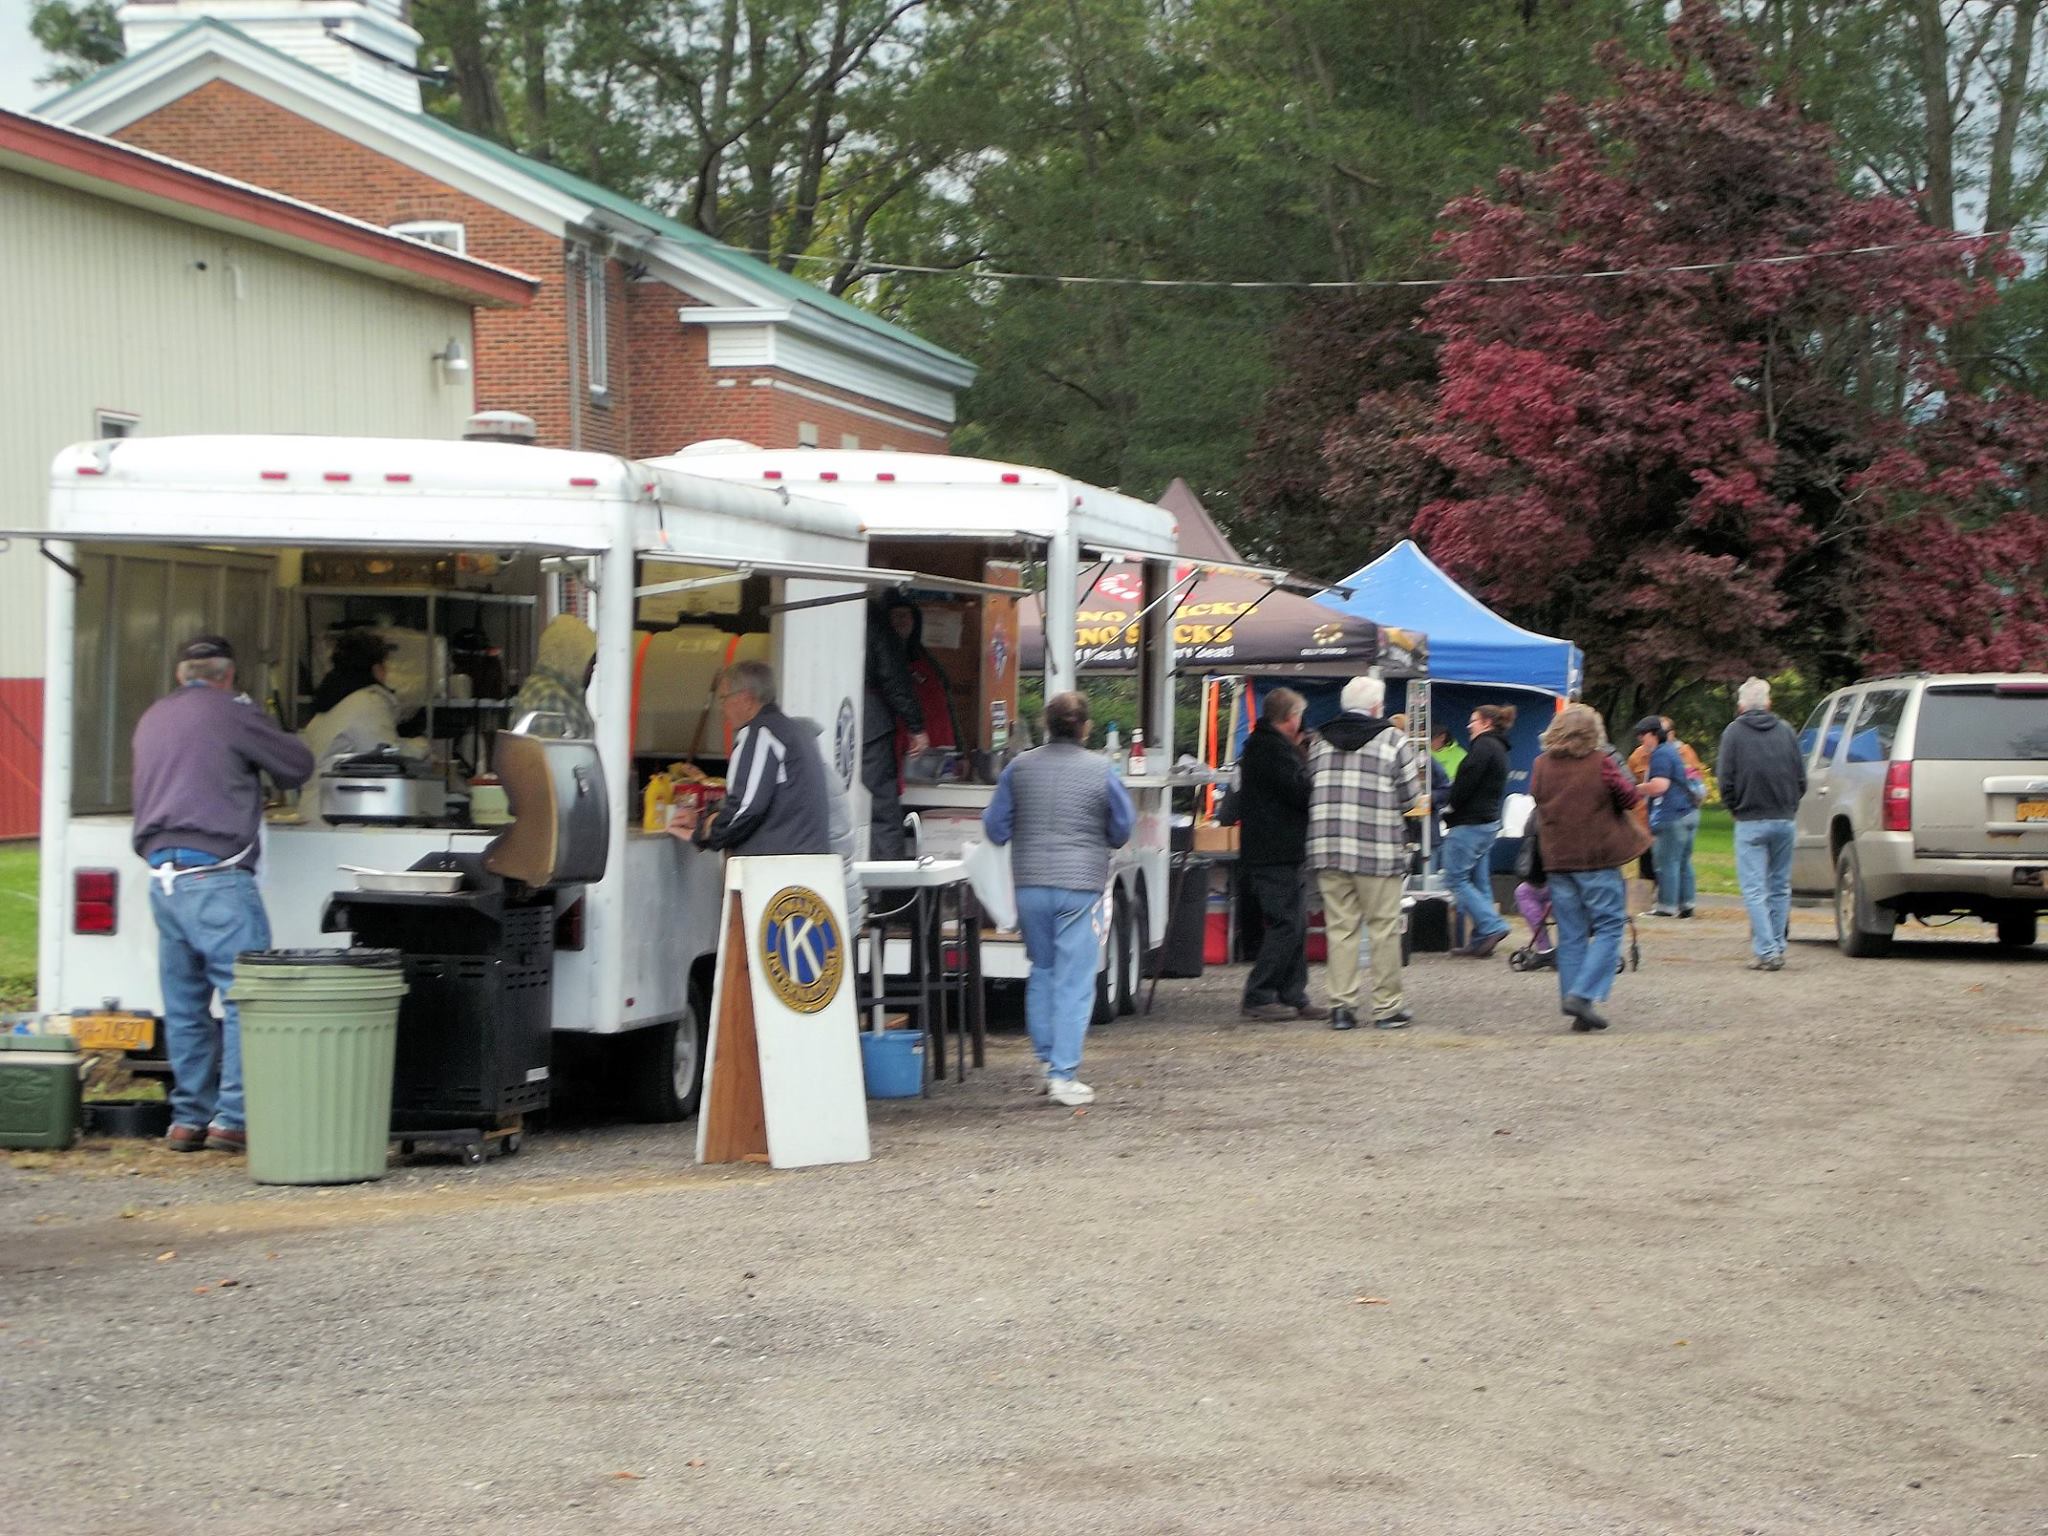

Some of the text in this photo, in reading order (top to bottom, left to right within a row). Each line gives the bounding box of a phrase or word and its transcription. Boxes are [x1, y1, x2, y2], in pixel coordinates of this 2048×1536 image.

[1076, 610, 1127, 622] NO
[1076, 626, 1120, 646] NO
[785, 917, 823, 984] K
